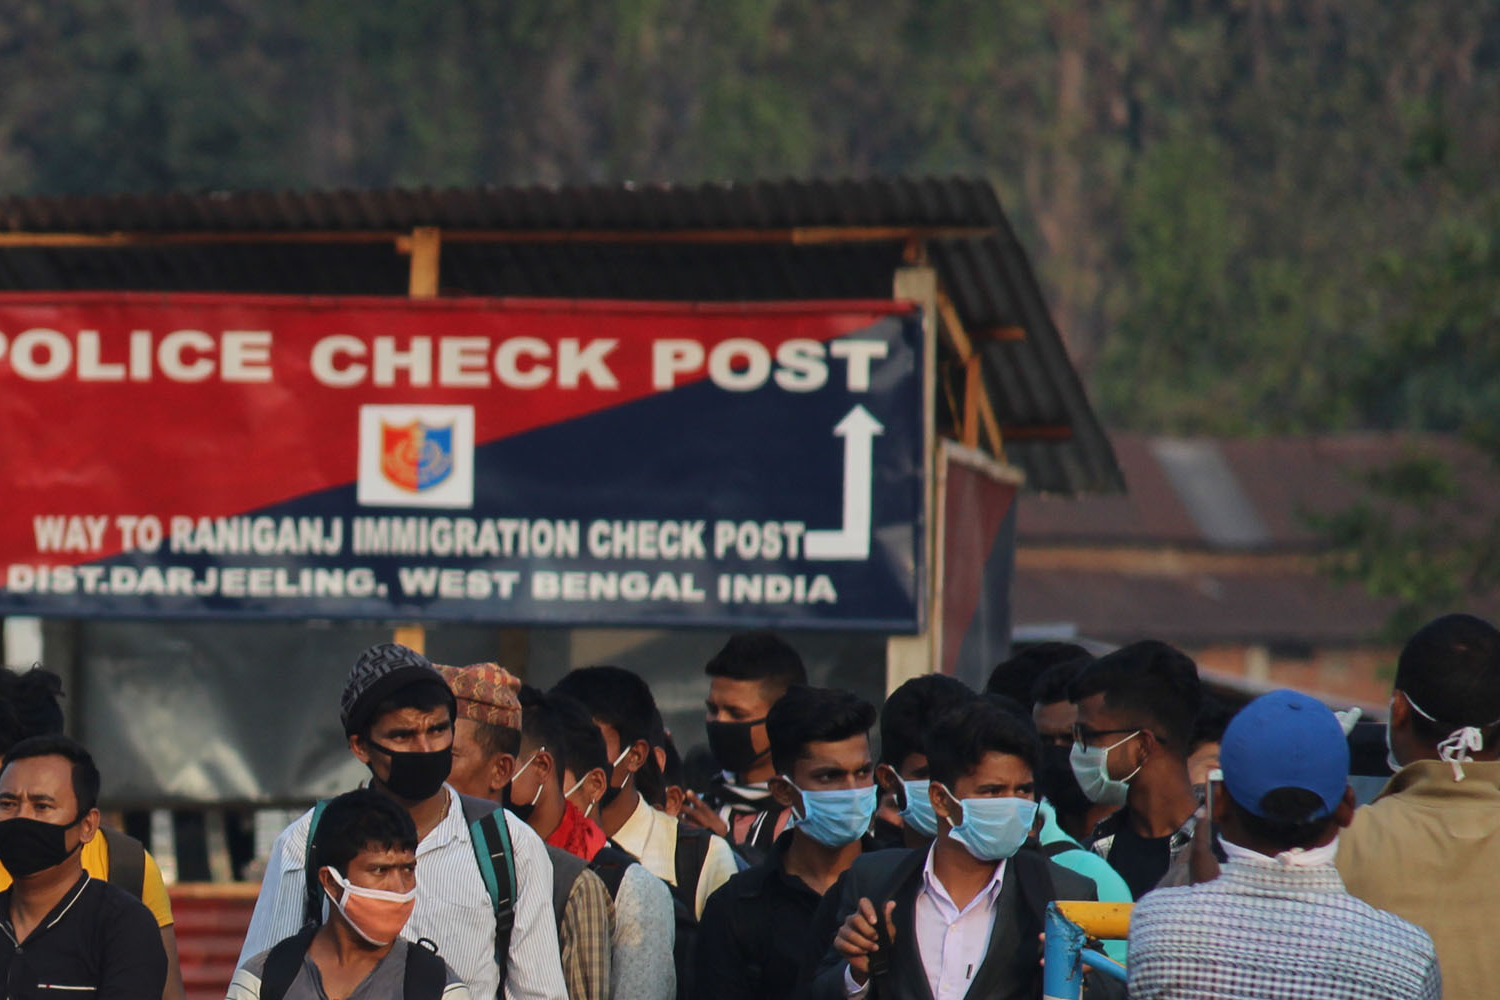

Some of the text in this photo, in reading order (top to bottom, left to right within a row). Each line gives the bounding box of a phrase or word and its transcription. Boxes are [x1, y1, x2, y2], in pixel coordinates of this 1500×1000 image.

[310, 334, 620, 390] CHECK
[652, 338, 889, 394] POST
[34, 515, 805, 560] WAY TO RANIGANJ IMMIGRATION CHECK POST
[399, 567, 520, 600] WEST
[530, 570, 706, 602] BENGAL
[717, 573, 838, 604] INDIA
